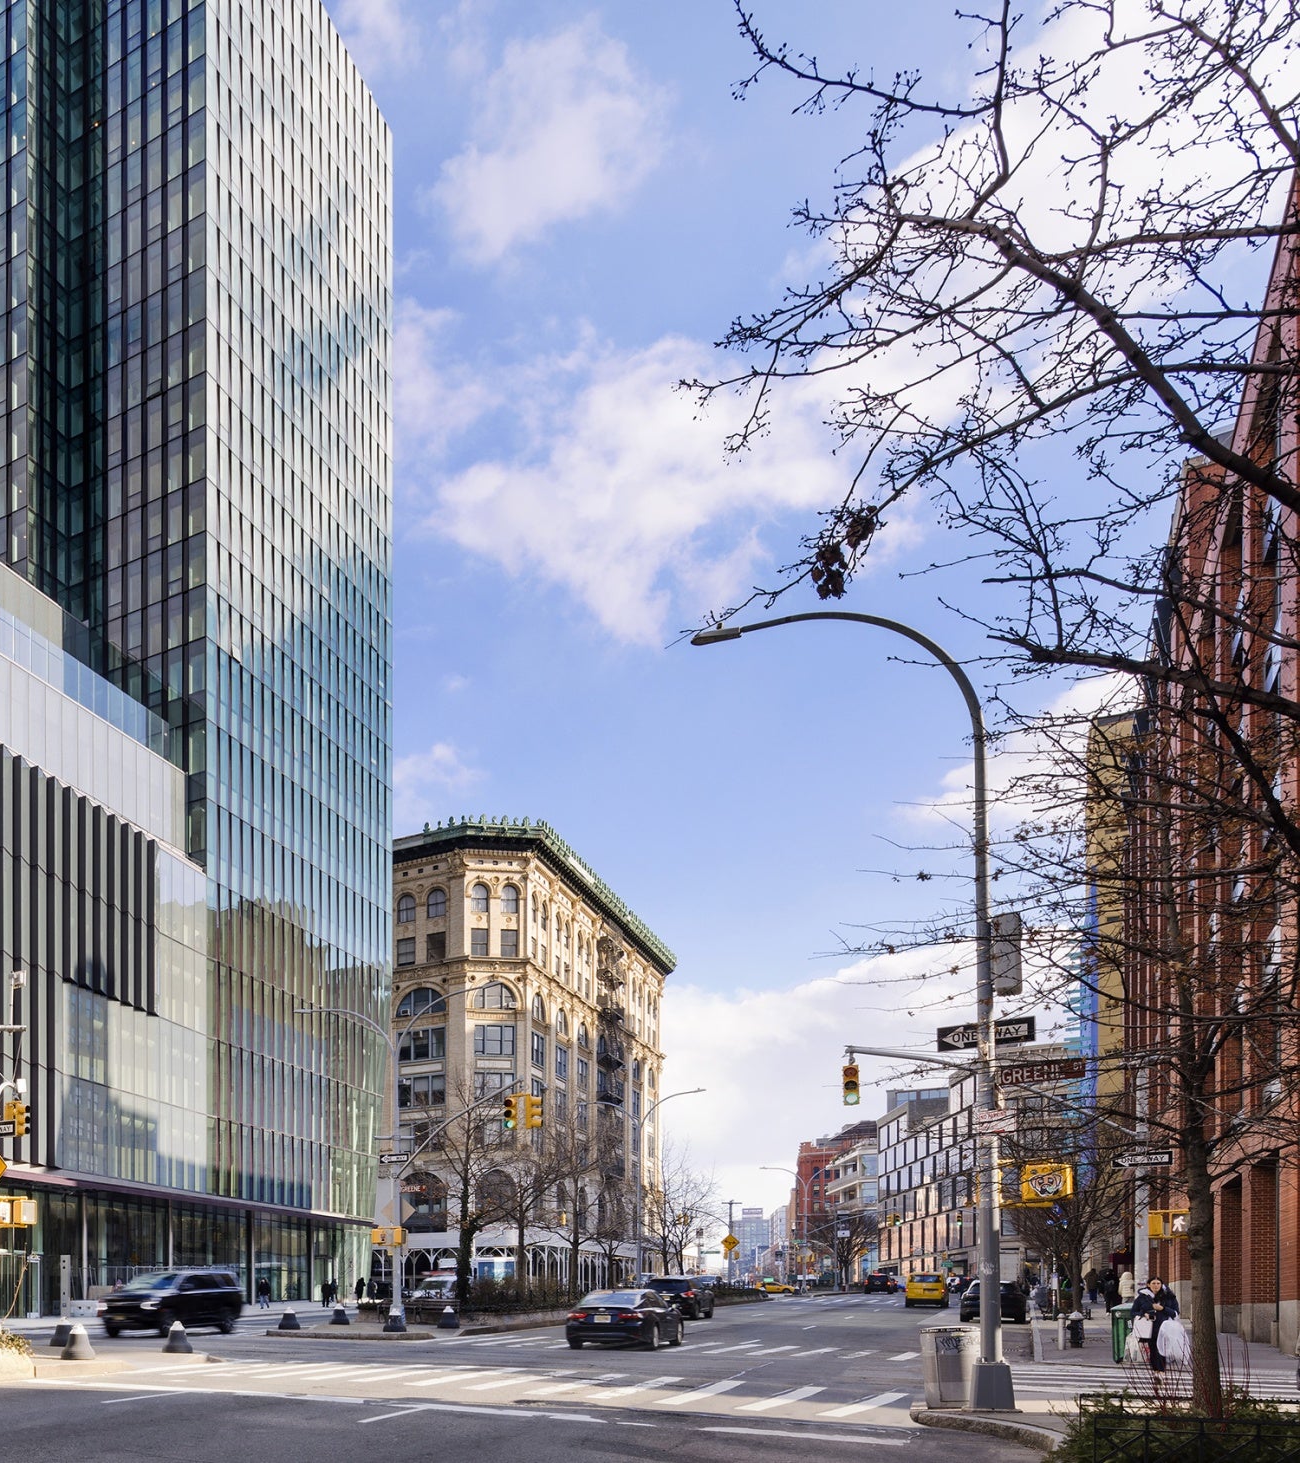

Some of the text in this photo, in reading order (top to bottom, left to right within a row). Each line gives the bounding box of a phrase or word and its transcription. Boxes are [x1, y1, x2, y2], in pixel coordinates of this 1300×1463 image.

[952, 1025, 1022, 1043] ONE WAY
[1146, 1155, 1165, 1163] WAY
